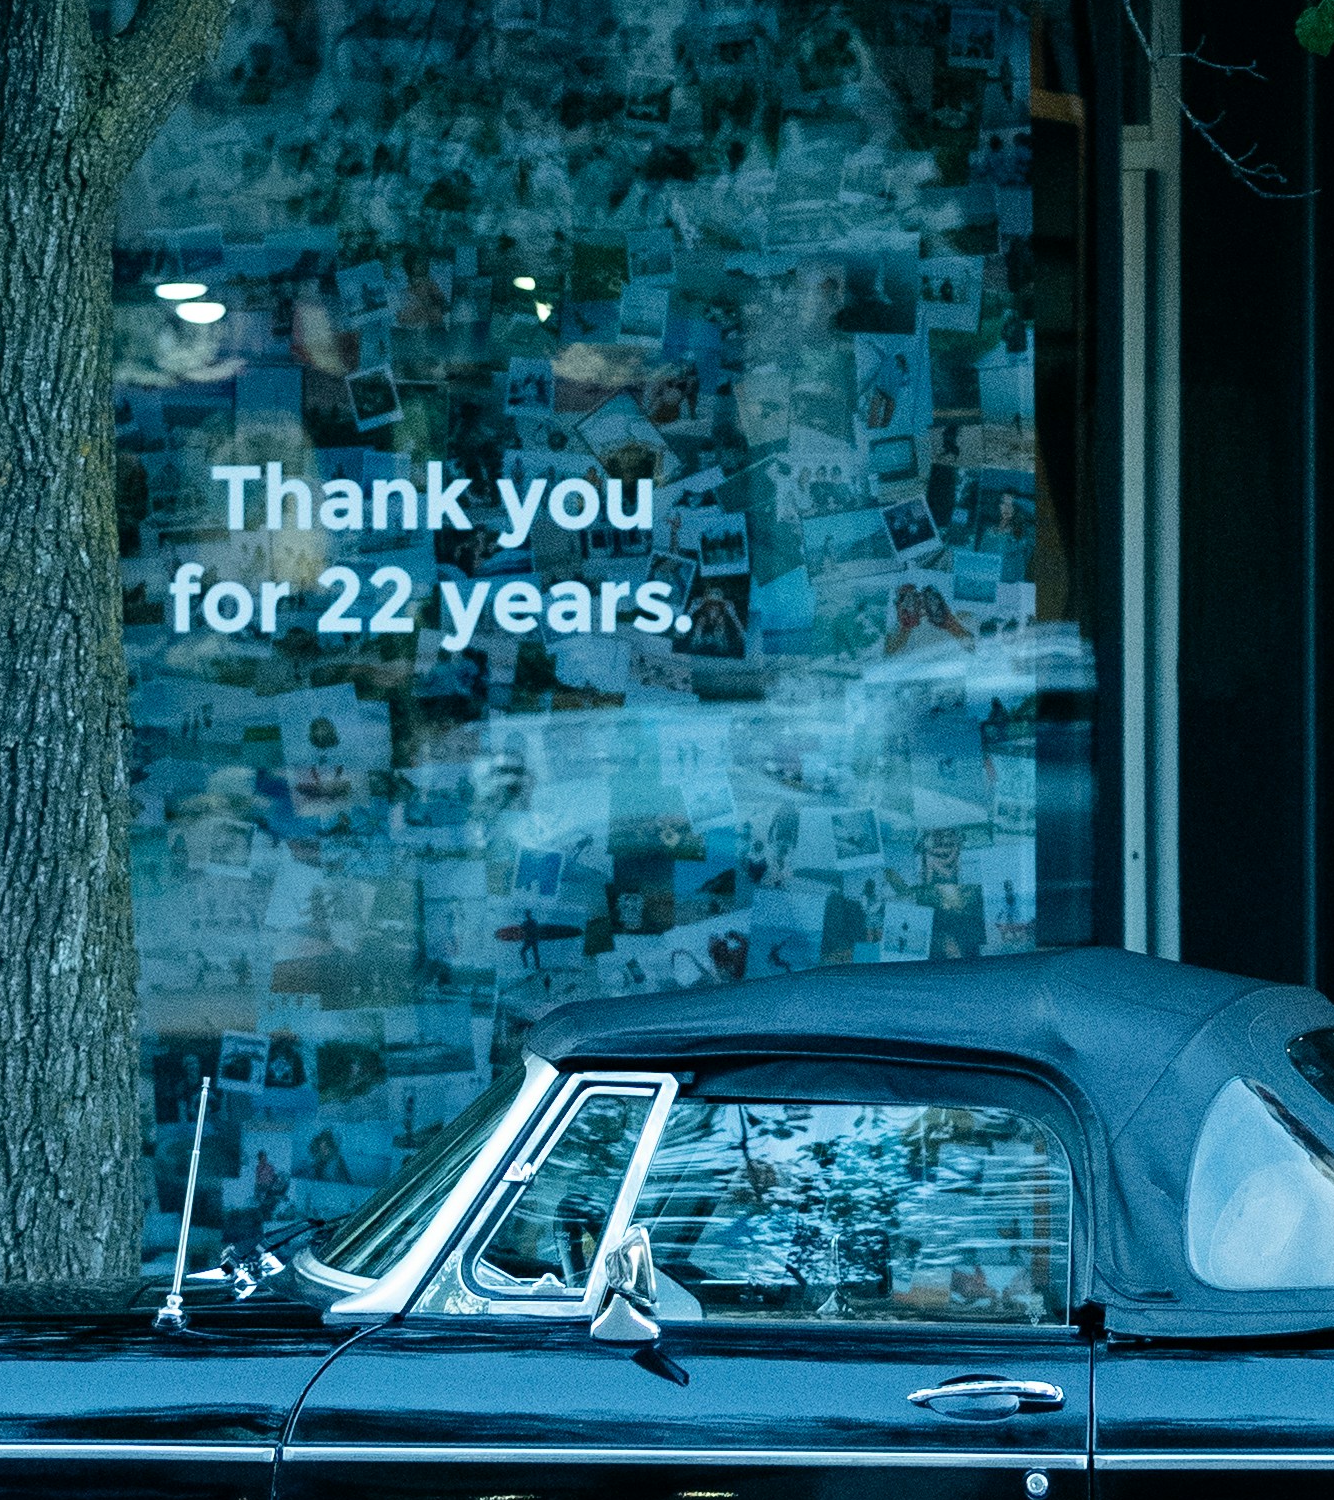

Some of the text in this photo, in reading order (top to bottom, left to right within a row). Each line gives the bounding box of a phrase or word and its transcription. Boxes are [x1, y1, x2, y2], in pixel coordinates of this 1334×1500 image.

[211, 461, 654, 548] Thank you
[169, 562, 693, 652] for 22 years.
